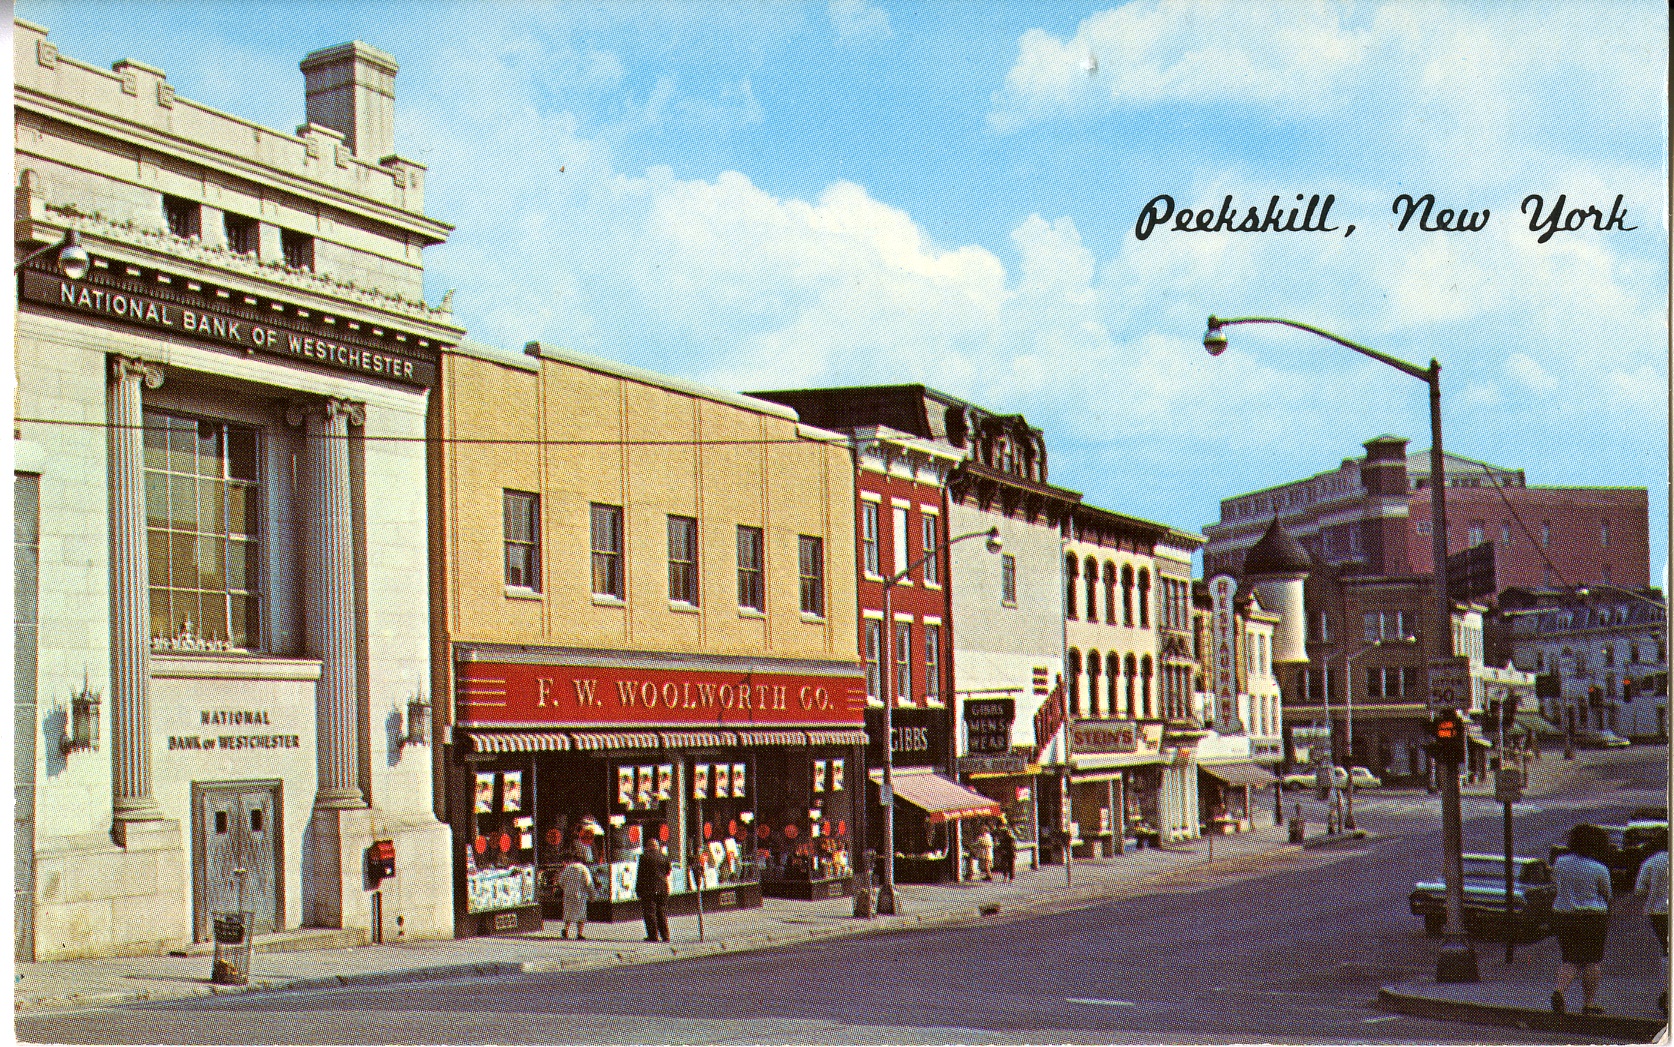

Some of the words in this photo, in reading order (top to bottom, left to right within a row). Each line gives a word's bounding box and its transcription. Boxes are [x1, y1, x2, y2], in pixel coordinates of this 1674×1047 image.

[60, 282, 172, 325] NATIONAL
[183, 313, 241, 342] BANK
[251, 328, 278, 347] OF
[287, 335, 414, 379] WESTCHESTER
[1217, 579, 1231, 728] RESTAURANT
[537, 678, 559, 708] F.
[572, 678, 602, 708] W.
[616, 680, 787, 710] WOOLWORTH
[799, 685, 834, 711] CO.
[200, 710, 270, 725] NATIONAL
[971, 703, 1004, 716] GIBBS
[168, 735, 201, 750] BANK
[218, 734, 300, 750] WESTCHESTER
[890, 726, 928, 752] GIBBS
[969, 735, 1005, 751] WEAR
